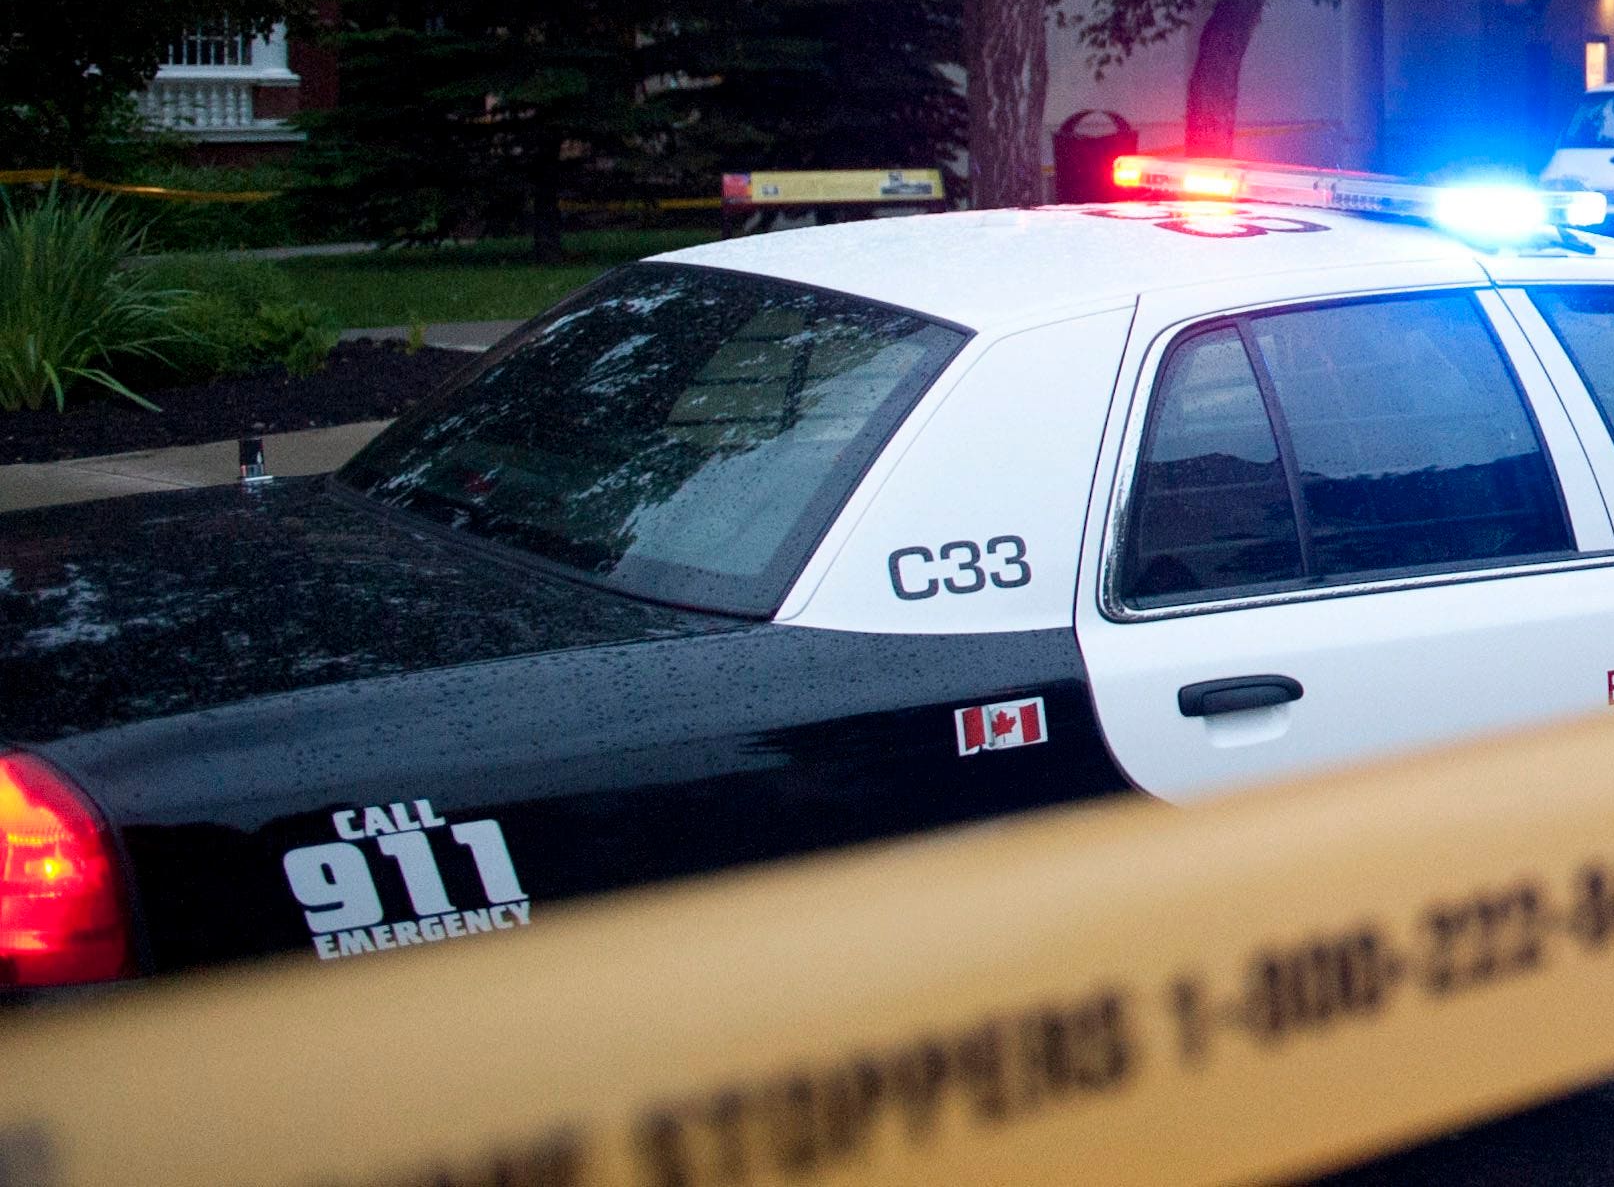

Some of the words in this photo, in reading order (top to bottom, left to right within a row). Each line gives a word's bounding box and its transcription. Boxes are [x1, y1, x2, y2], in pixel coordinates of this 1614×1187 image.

[888, 534, 1032, 601] C33
[331, 799, 446, 841] CALL
[282, 818, 530, 934] 911
[311, 901, 531, 961] EMERGENCY
